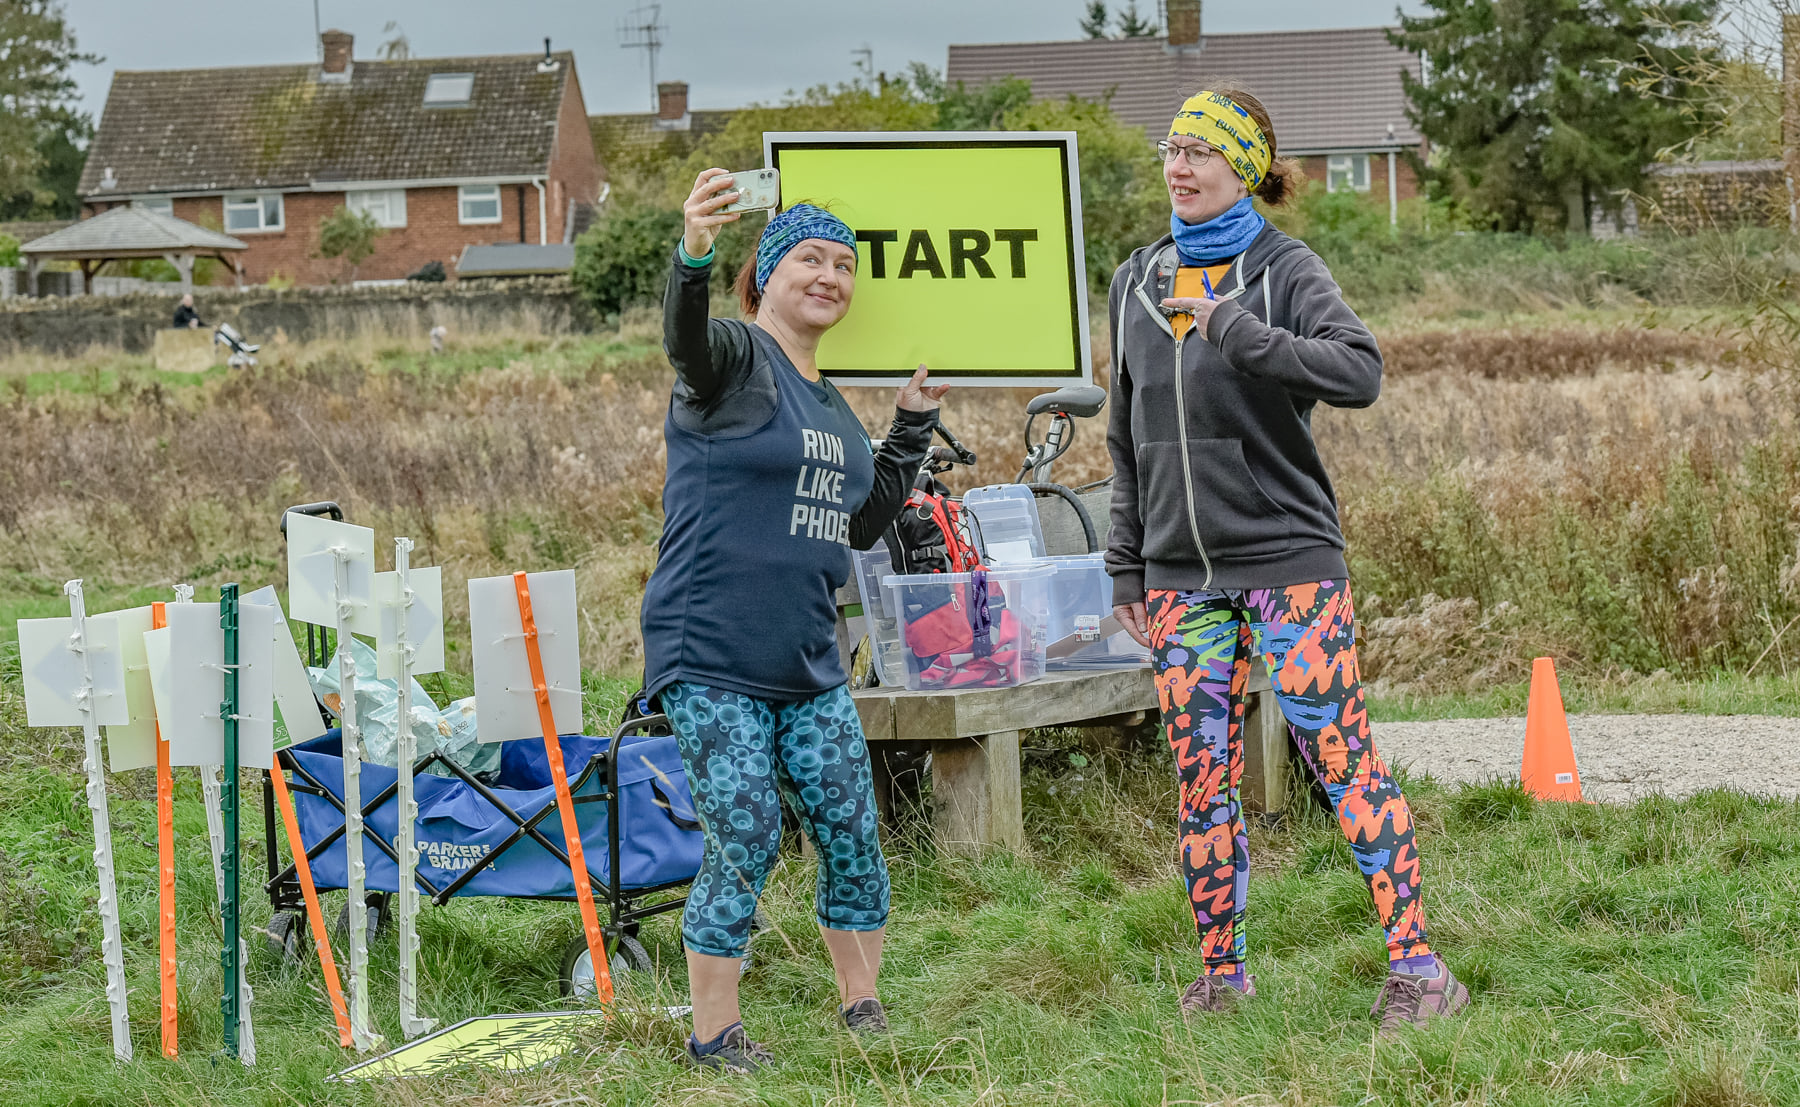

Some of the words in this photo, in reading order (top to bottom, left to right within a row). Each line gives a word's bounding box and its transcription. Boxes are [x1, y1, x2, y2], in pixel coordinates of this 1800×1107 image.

[855, 229, 1039, 279] TART
[801, 428, 845, 467] RUN
[795, 465, 846, 505] LIKE
[789, 503, 851, 547] PHOE
